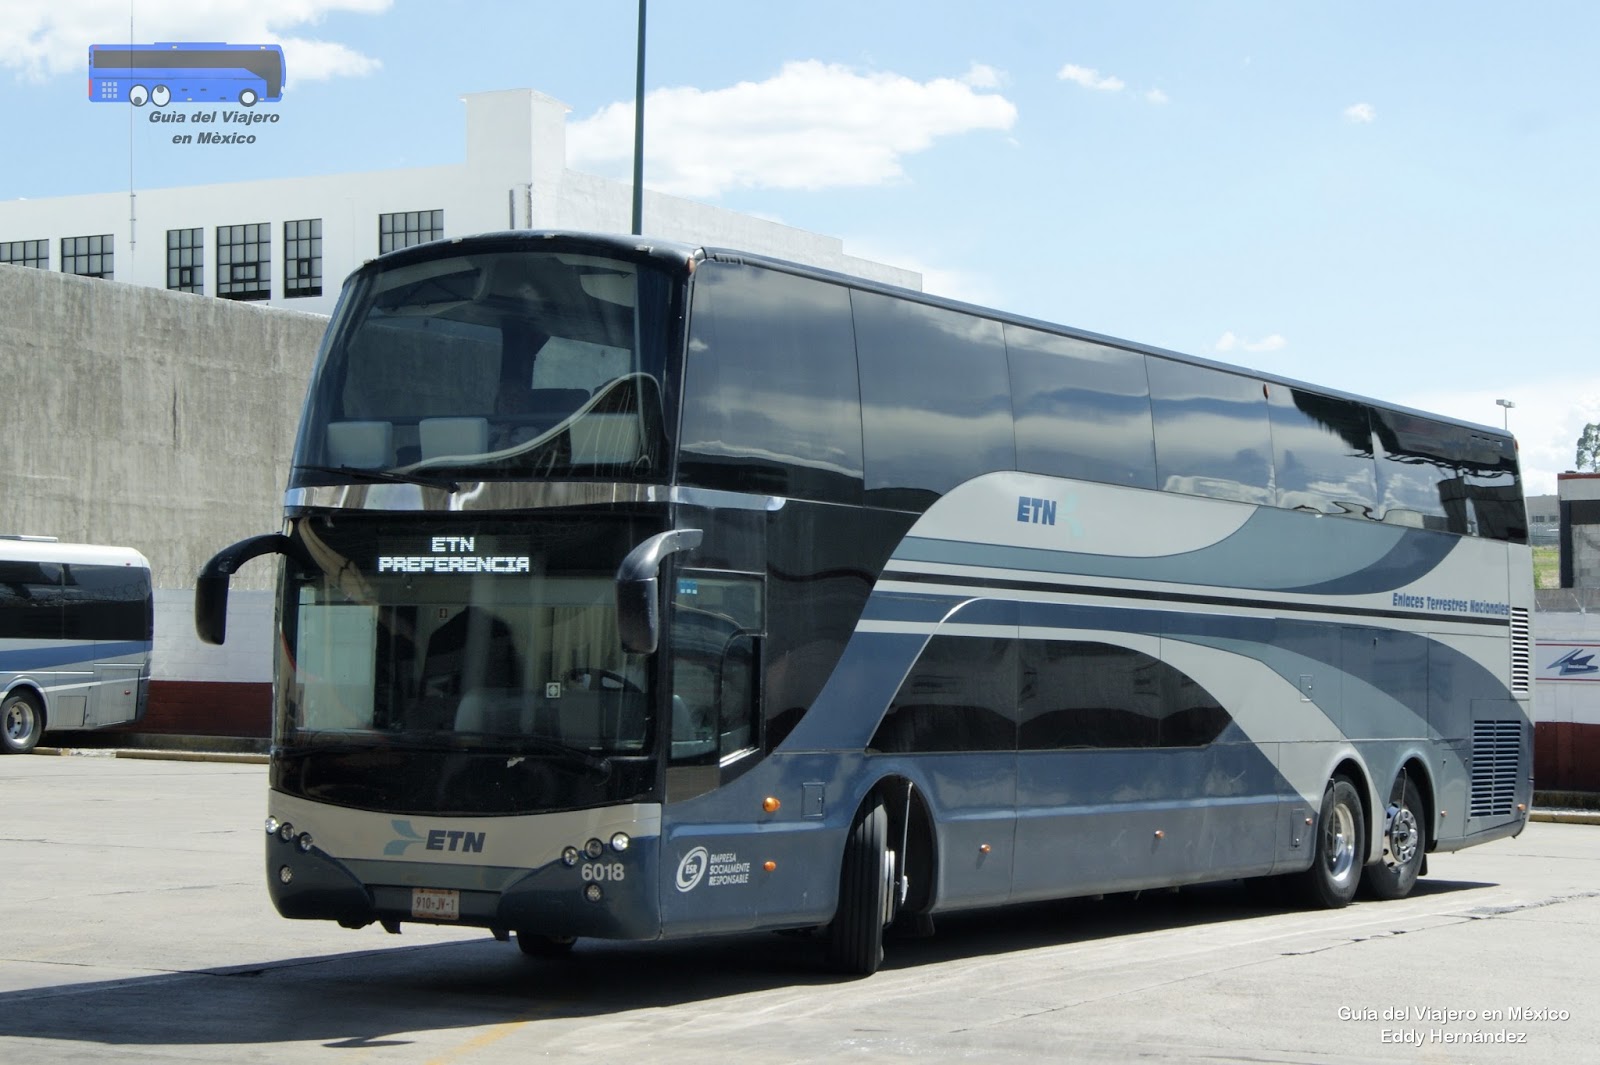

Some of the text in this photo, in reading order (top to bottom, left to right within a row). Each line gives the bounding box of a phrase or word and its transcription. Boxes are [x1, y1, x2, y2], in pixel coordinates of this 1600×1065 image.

[1017, 496, 1057, 526] ETN
[431, 536, 475, 552] ETN
[378, 556, 530, 572] PREFERENCIA
[1392, 592, 1509, 616] Enlaces Terrestres Nacionales
[425, 829, 486, 853] ETN
[710, 852, 737, 864] EMPRESA
[581, 863, 625, 882] 6018
[685, 864, 698, 874] ESR
[709, 862, 750, 875] SOCIALMENTE
[708, 873, 749, 886] RESPONSABLE
